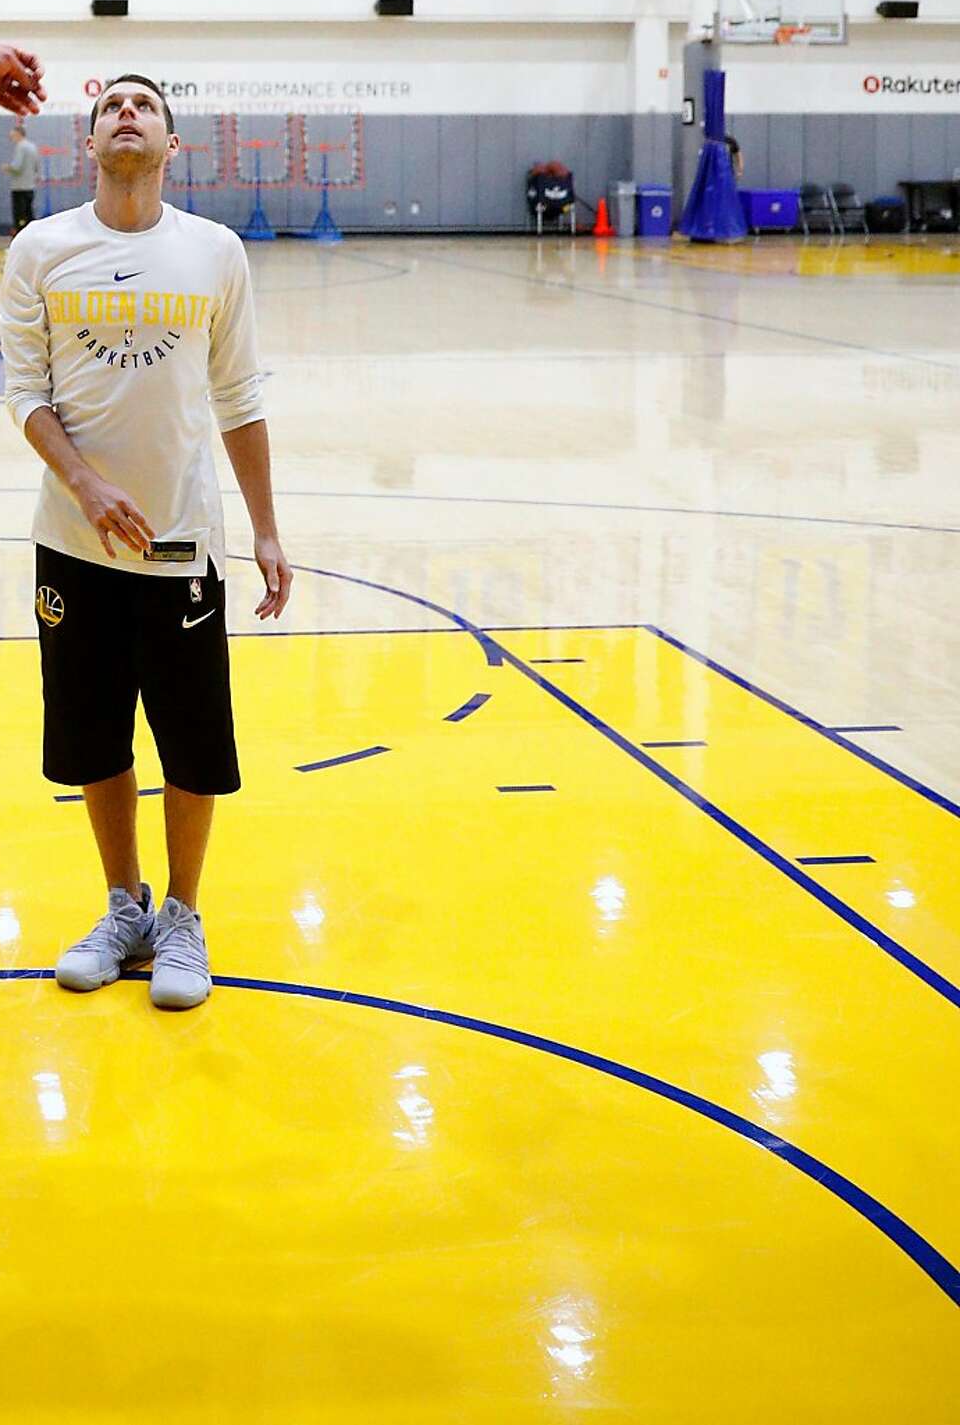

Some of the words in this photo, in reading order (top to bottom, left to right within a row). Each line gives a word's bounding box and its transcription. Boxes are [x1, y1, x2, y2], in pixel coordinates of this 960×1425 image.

[205, 80, 337, 98] PERFORMANCE
[342, 80, 411, 98] CENTER
[76, 328, 182, 369] BASKETBALL
